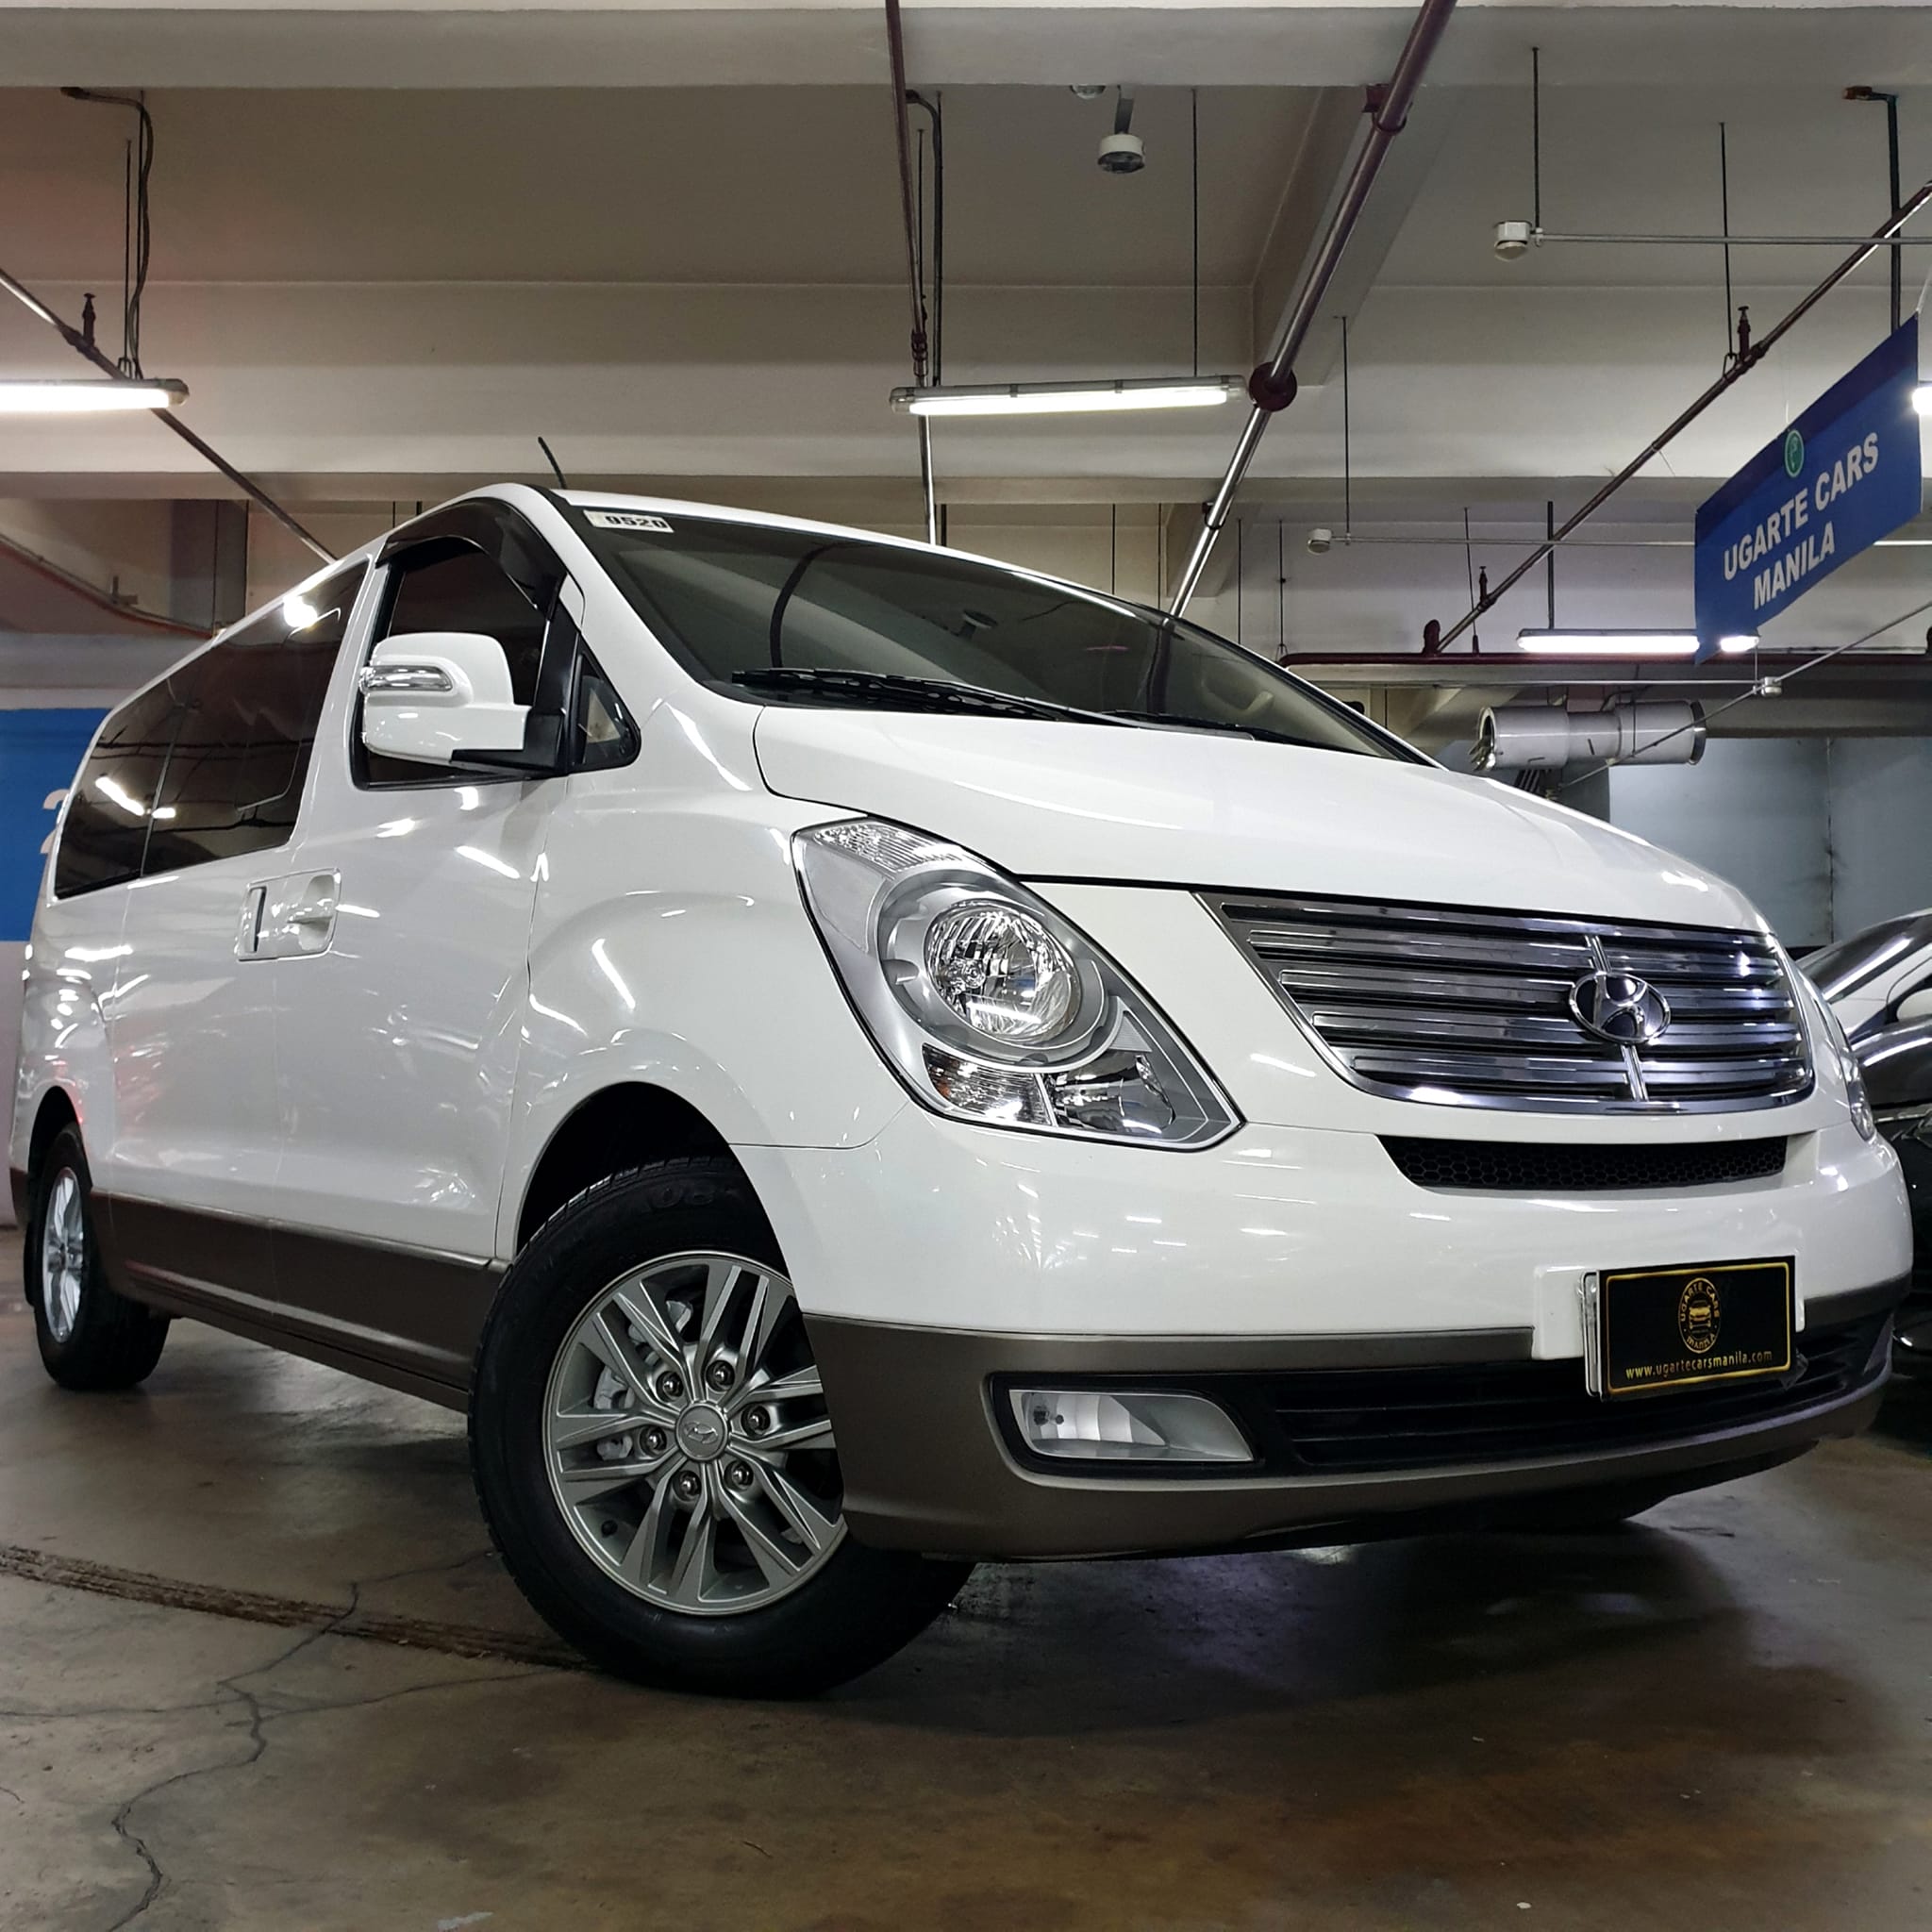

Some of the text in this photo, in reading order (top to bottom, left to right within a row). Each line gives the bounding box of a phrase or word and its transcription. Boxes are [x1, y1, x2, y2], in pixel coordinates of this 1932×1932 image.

[1724, 432, 1879, 581] UGARTE CARS
[1754, 522, 1836, 610] MANILA
[1625, 1350, 1773, 1380] www.ugartecarsmanila.com
